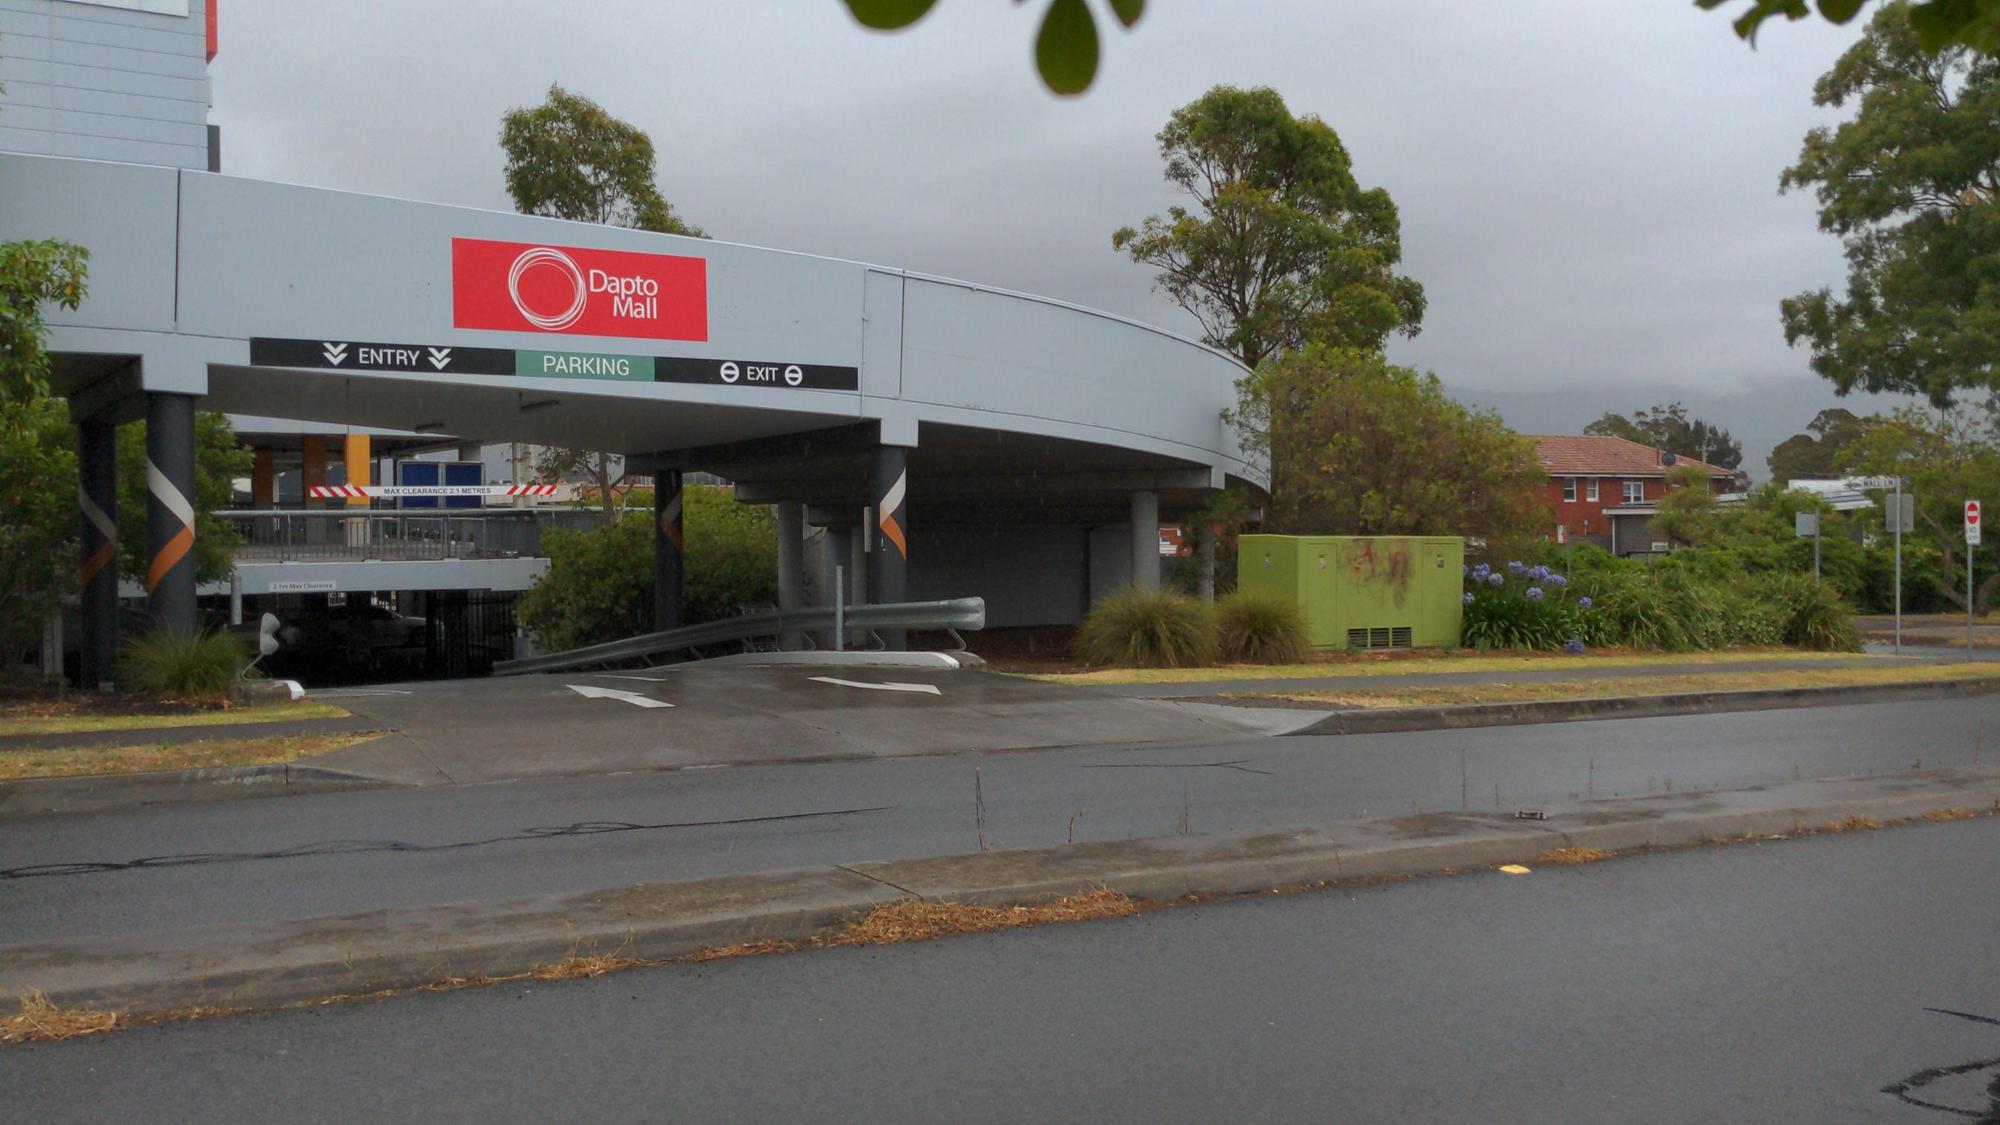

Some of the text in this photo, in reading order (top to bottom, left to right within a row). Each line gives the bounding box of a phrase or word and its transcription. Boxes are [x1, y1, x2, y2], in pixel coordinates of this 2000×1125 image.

[589, 269, 658, 300] Dapto
[612, 296, 657, 319] Mall
[358, 348, 420, 366] ENTRY
[543, 356, 630, 376] PARKING
[746, 366, 778, 382] EXIT
